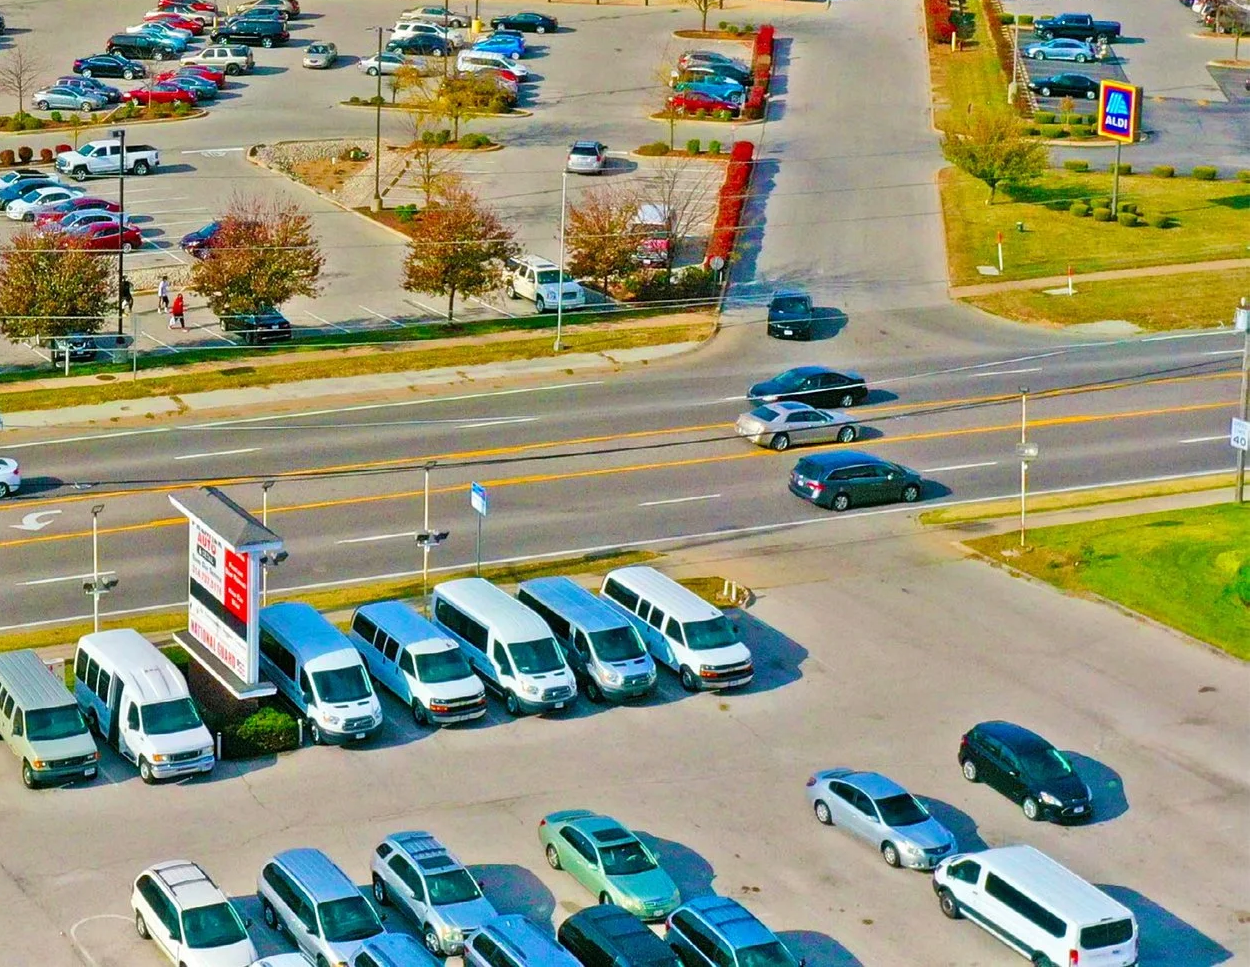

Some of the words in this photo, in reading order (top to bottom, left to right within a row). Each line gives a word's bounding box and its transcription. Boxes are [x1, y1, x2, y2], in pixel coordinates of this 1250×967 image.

[1105, 115, 1128, 130] ALDI
[1233, 435, 1246, 446] 40
[197, 533, 217, 555] AUTO
